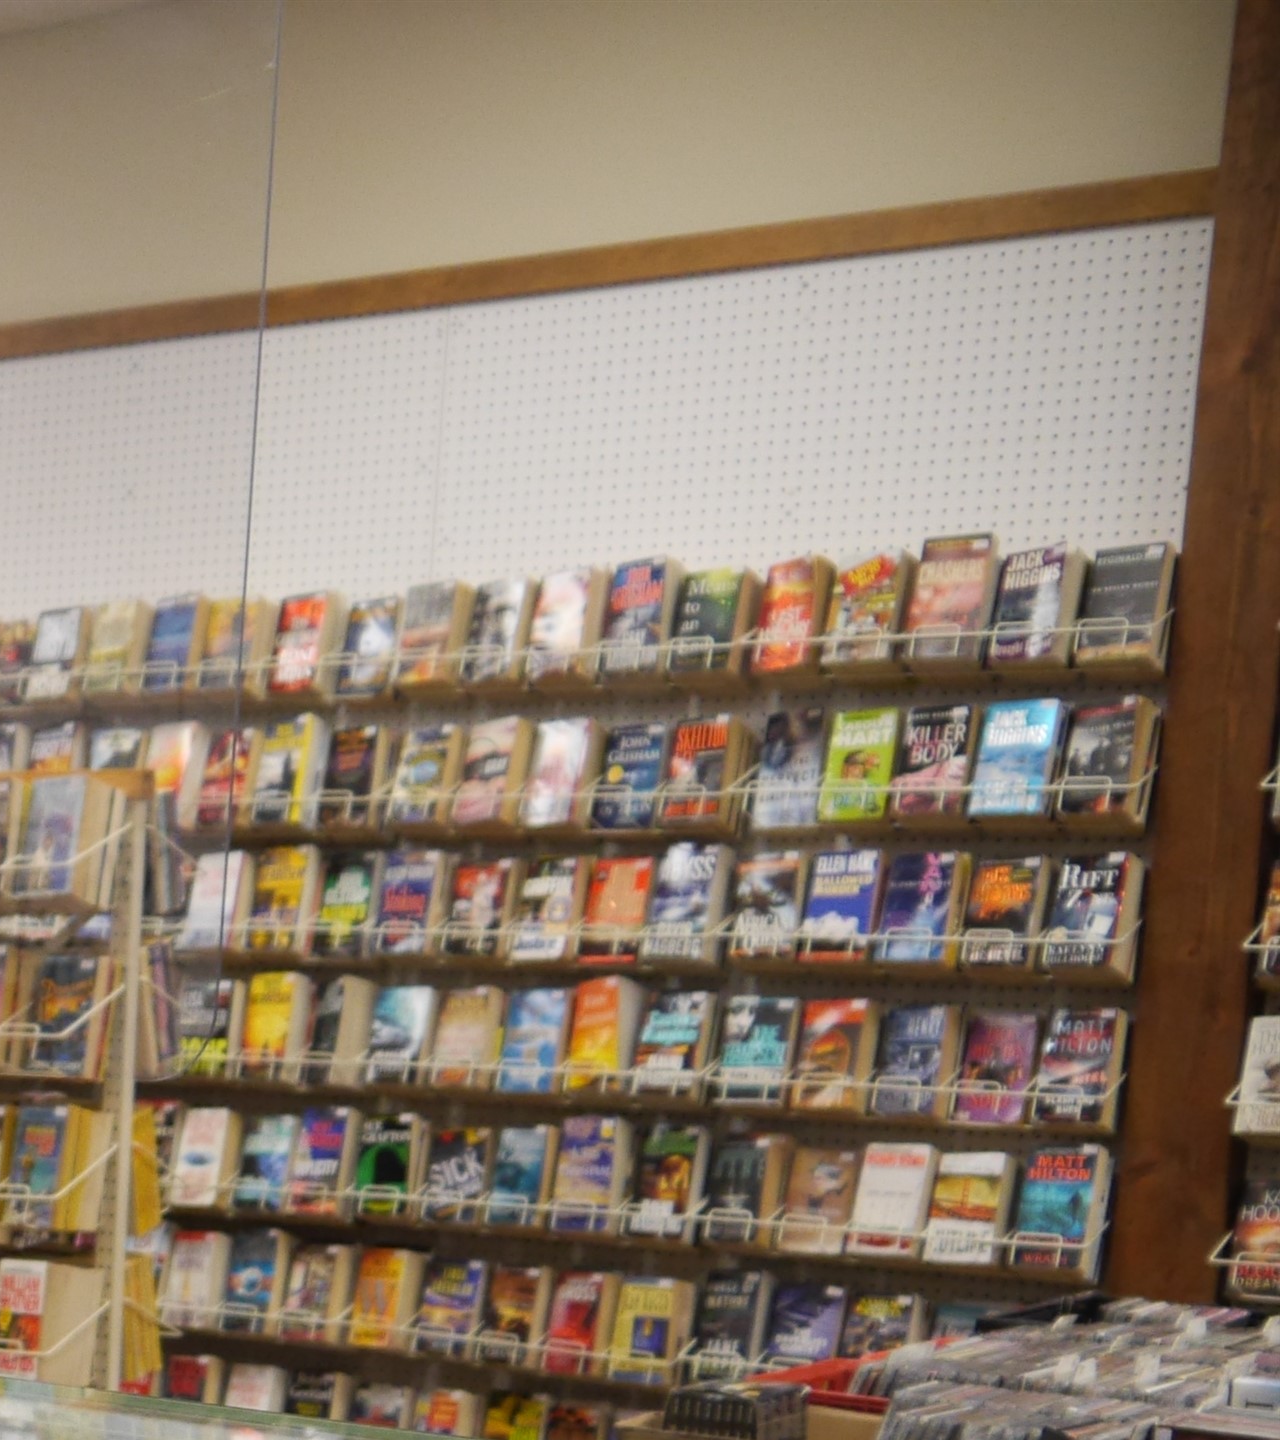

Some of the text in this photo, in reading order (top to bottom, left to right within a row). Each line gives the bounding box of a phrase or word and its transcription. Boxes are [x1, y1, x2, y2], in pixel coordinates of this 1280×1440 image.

[1008, 550, 1046, 572] JACK
[1005, 563, 1062, 590] HIGGINS
[993, 708, 1029, 728] JACK
[619, 735, 652, 749] JOHN
[836, 726, 894, 748] HART
[909, 724, 967, 745] KILLER
[986, 725, 1049, 747] HIGGINS
[608, 747, 661, 763] GRISHAM
[911, 743, 959, 764] BODY
[1060, 863, 1120, 888] RIFT
[1044, 1036, 1112, 1054] HILTON
[1037, 1154, 1088, 1168] MATT
[1028, 1167, 1091, 1181] HILTON
